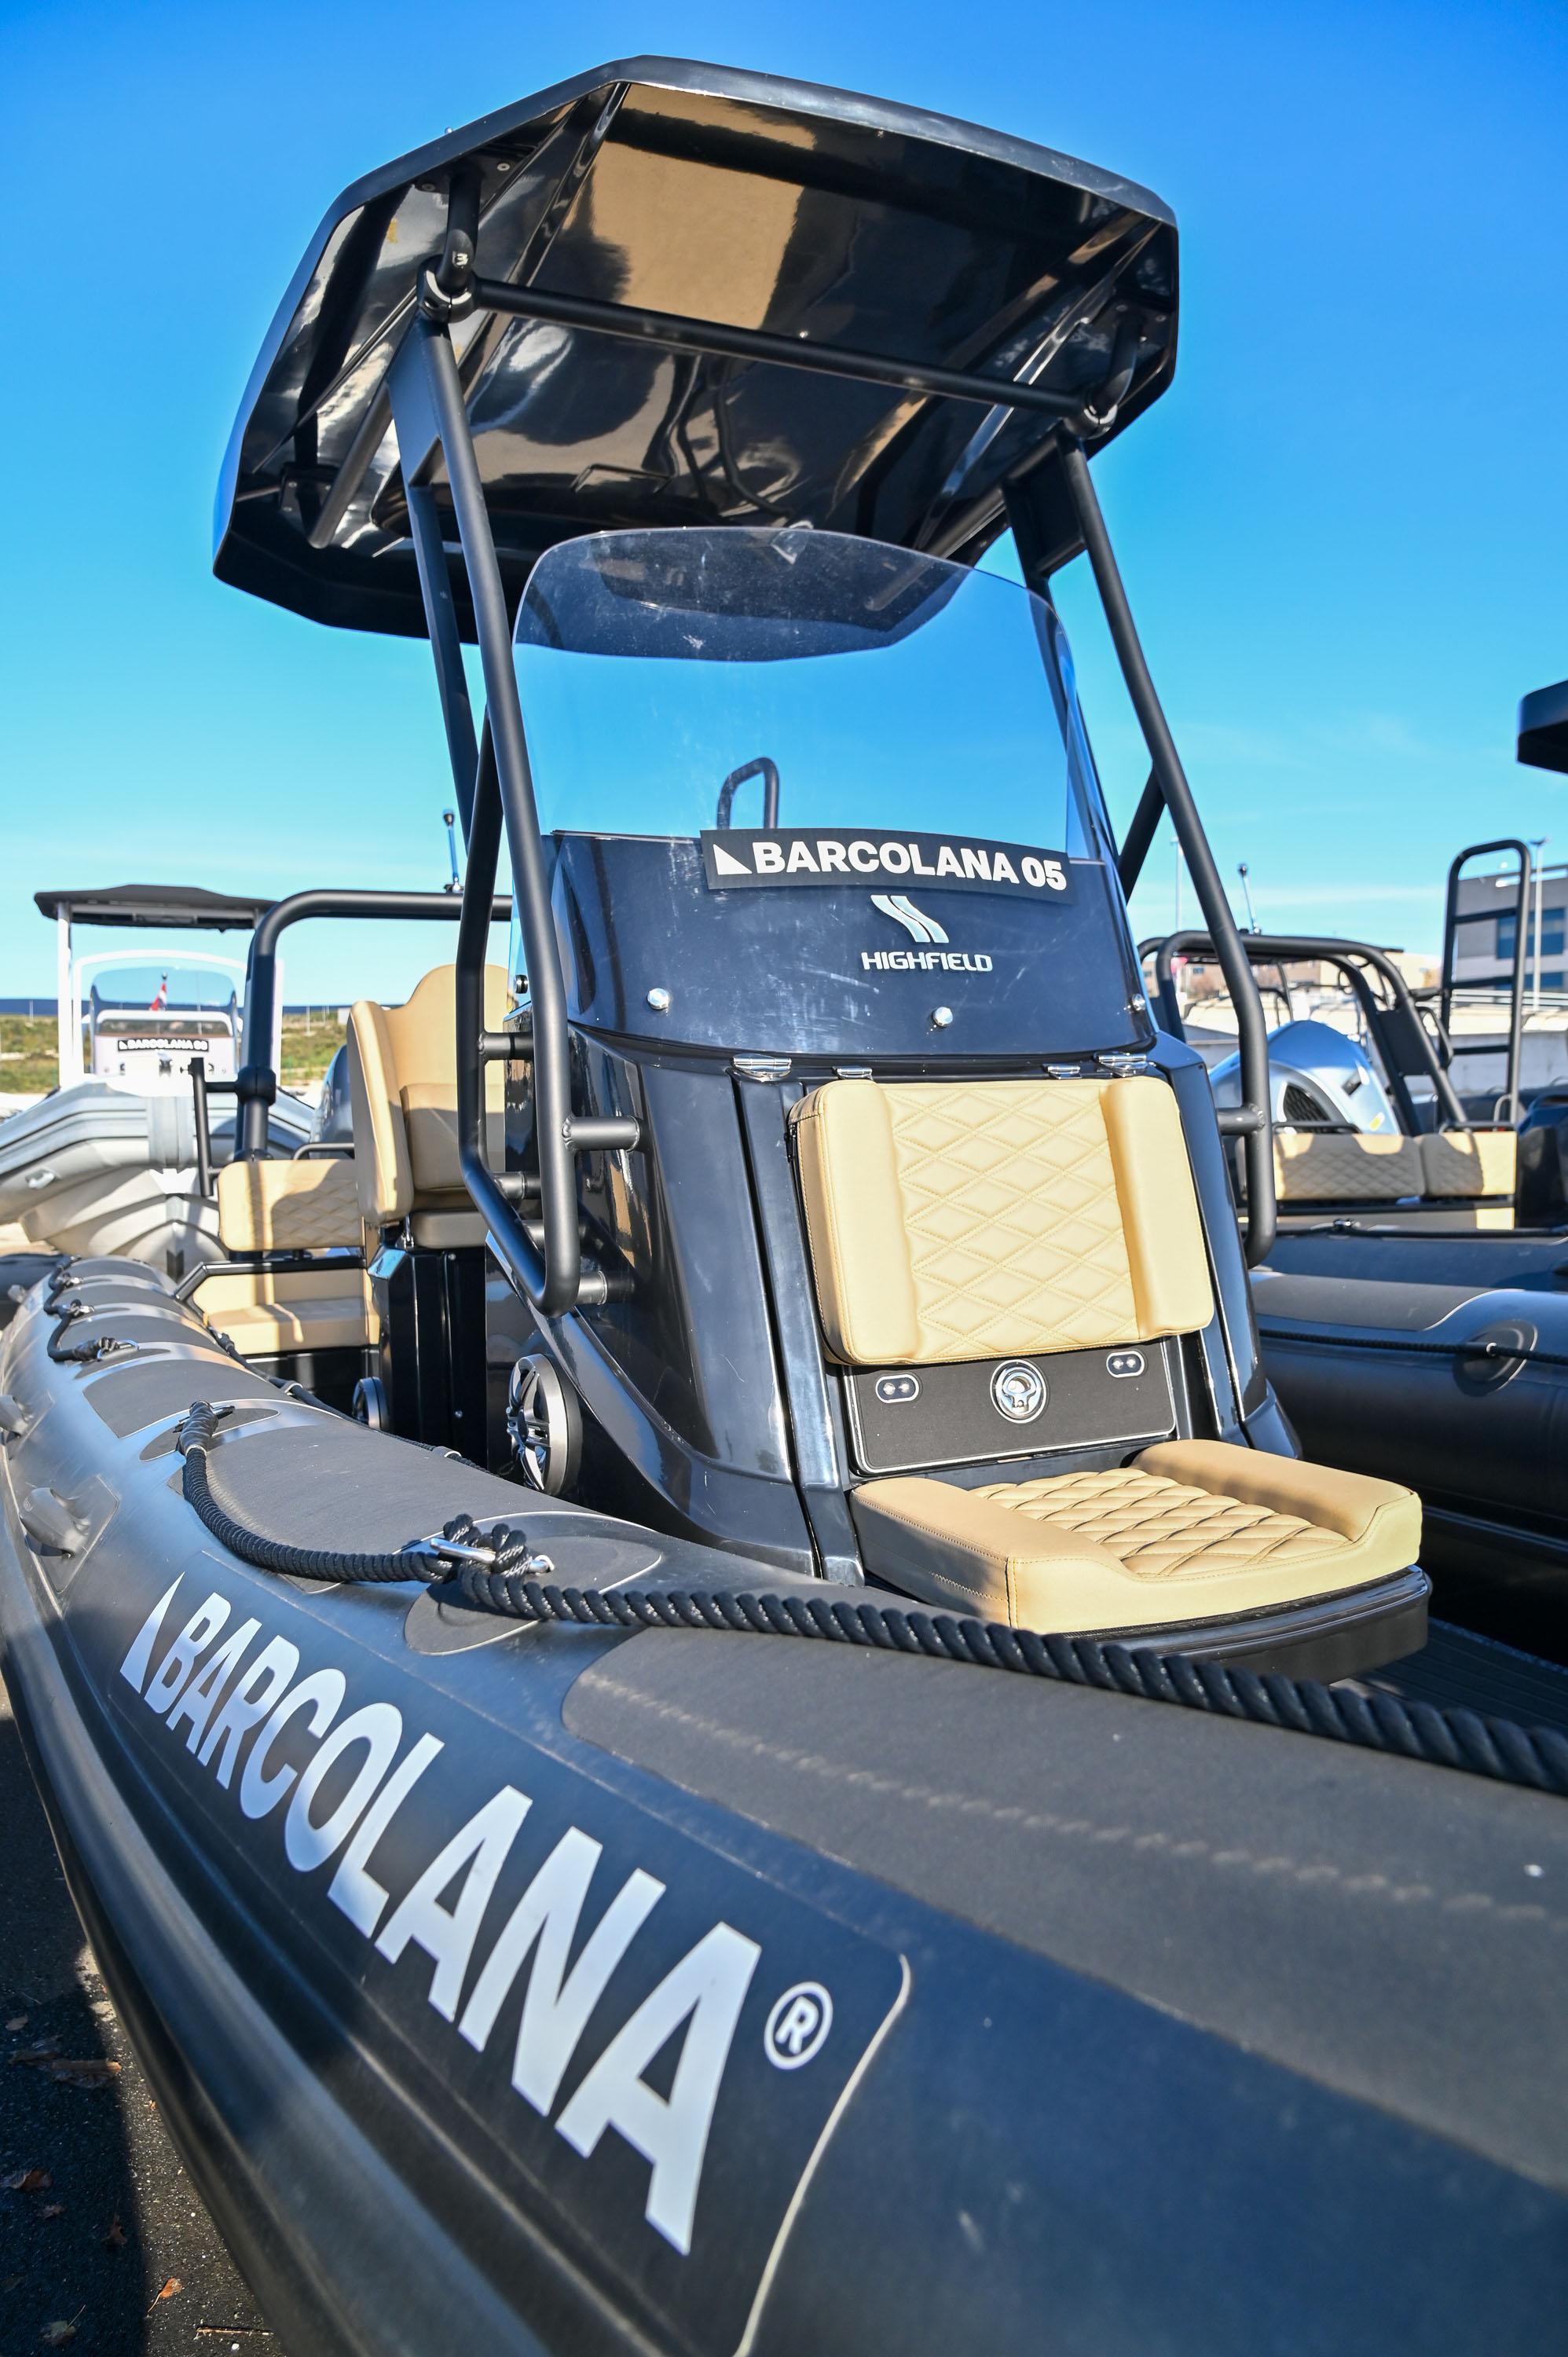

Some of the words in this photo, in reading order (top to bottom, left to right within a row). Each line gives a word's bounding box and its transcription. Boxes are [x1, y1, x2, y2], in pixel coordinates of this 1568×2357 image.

[751, 841, 1020, 885] BARCOLANA
[1021, 856, 1067, 891] 05
[861, 951, 993, 972] HIGHFIELD
